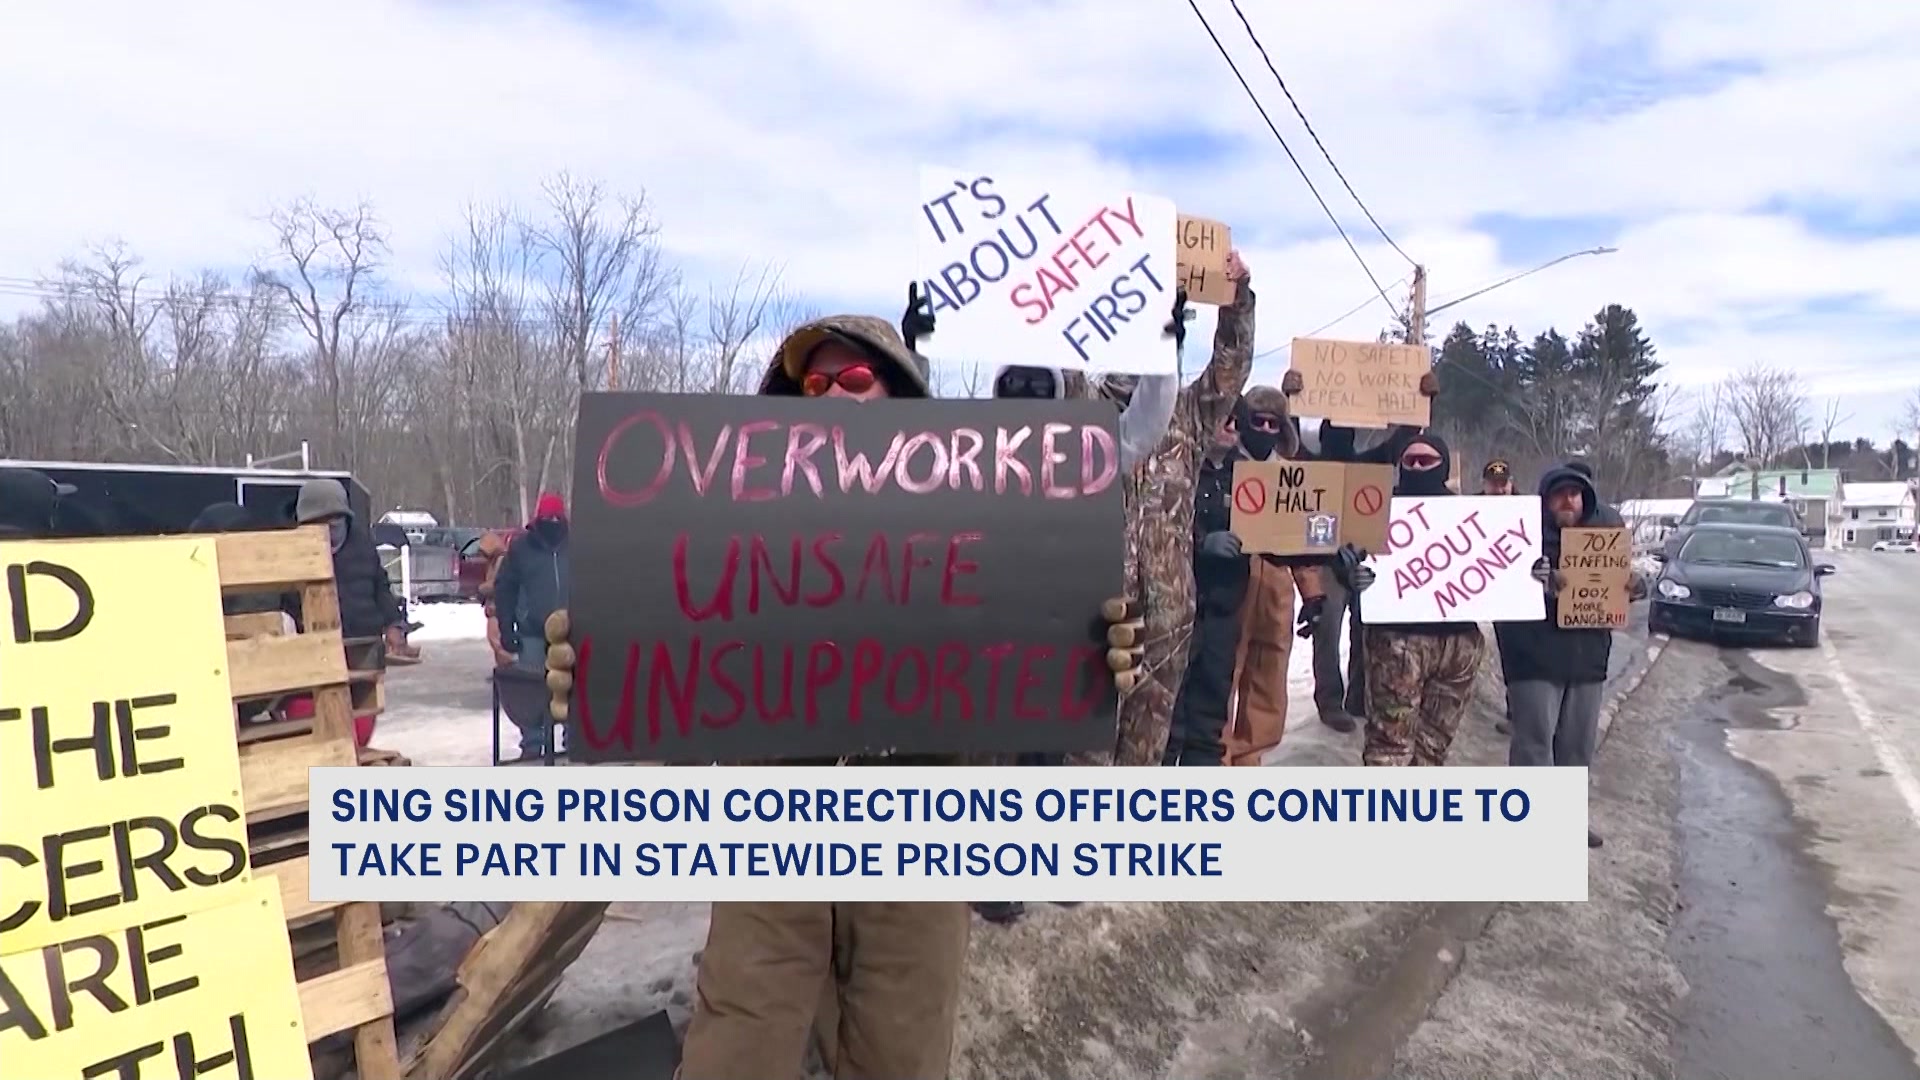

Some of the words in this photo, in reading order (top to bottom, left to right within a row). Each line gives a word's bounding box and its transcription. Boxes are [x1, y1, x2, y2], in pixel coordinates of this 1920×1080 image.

[922, 176, 1006, 243] IT'S
[923, 193, 1063, 316] ABOUT
[1009, 196, 1145, 325] SAFETY
[1062, 252, 1164, 362] FIRST
[1314, 342, 1348, 365] NO
[1315, 370, 1346, 387] NO
[1359, 370, 1412, 389] WORK
[1377, 391, 1418, 411] HALT
[596, 409, 1119, 508] OVERWORKED
[1279, 466, 1304, 487] NO
[1275, 489, 1327, 513] HALT
[1371, 502, 1430, 563] OT
[1394, 511, 1487, 599] ABOUT
[1562, 555, 1628, 568] STAFFING
[1583, 531, 1621, 552] 70%
[672, 532, 985, 622] UNSAFE
[1433, 518, 1533, 618] MONEY
[1572, 587, 1609, 600] 100%
[1573, 602, 1605, 615] MORE
[574, 634, 1107, 752] UNSUPPORTED
